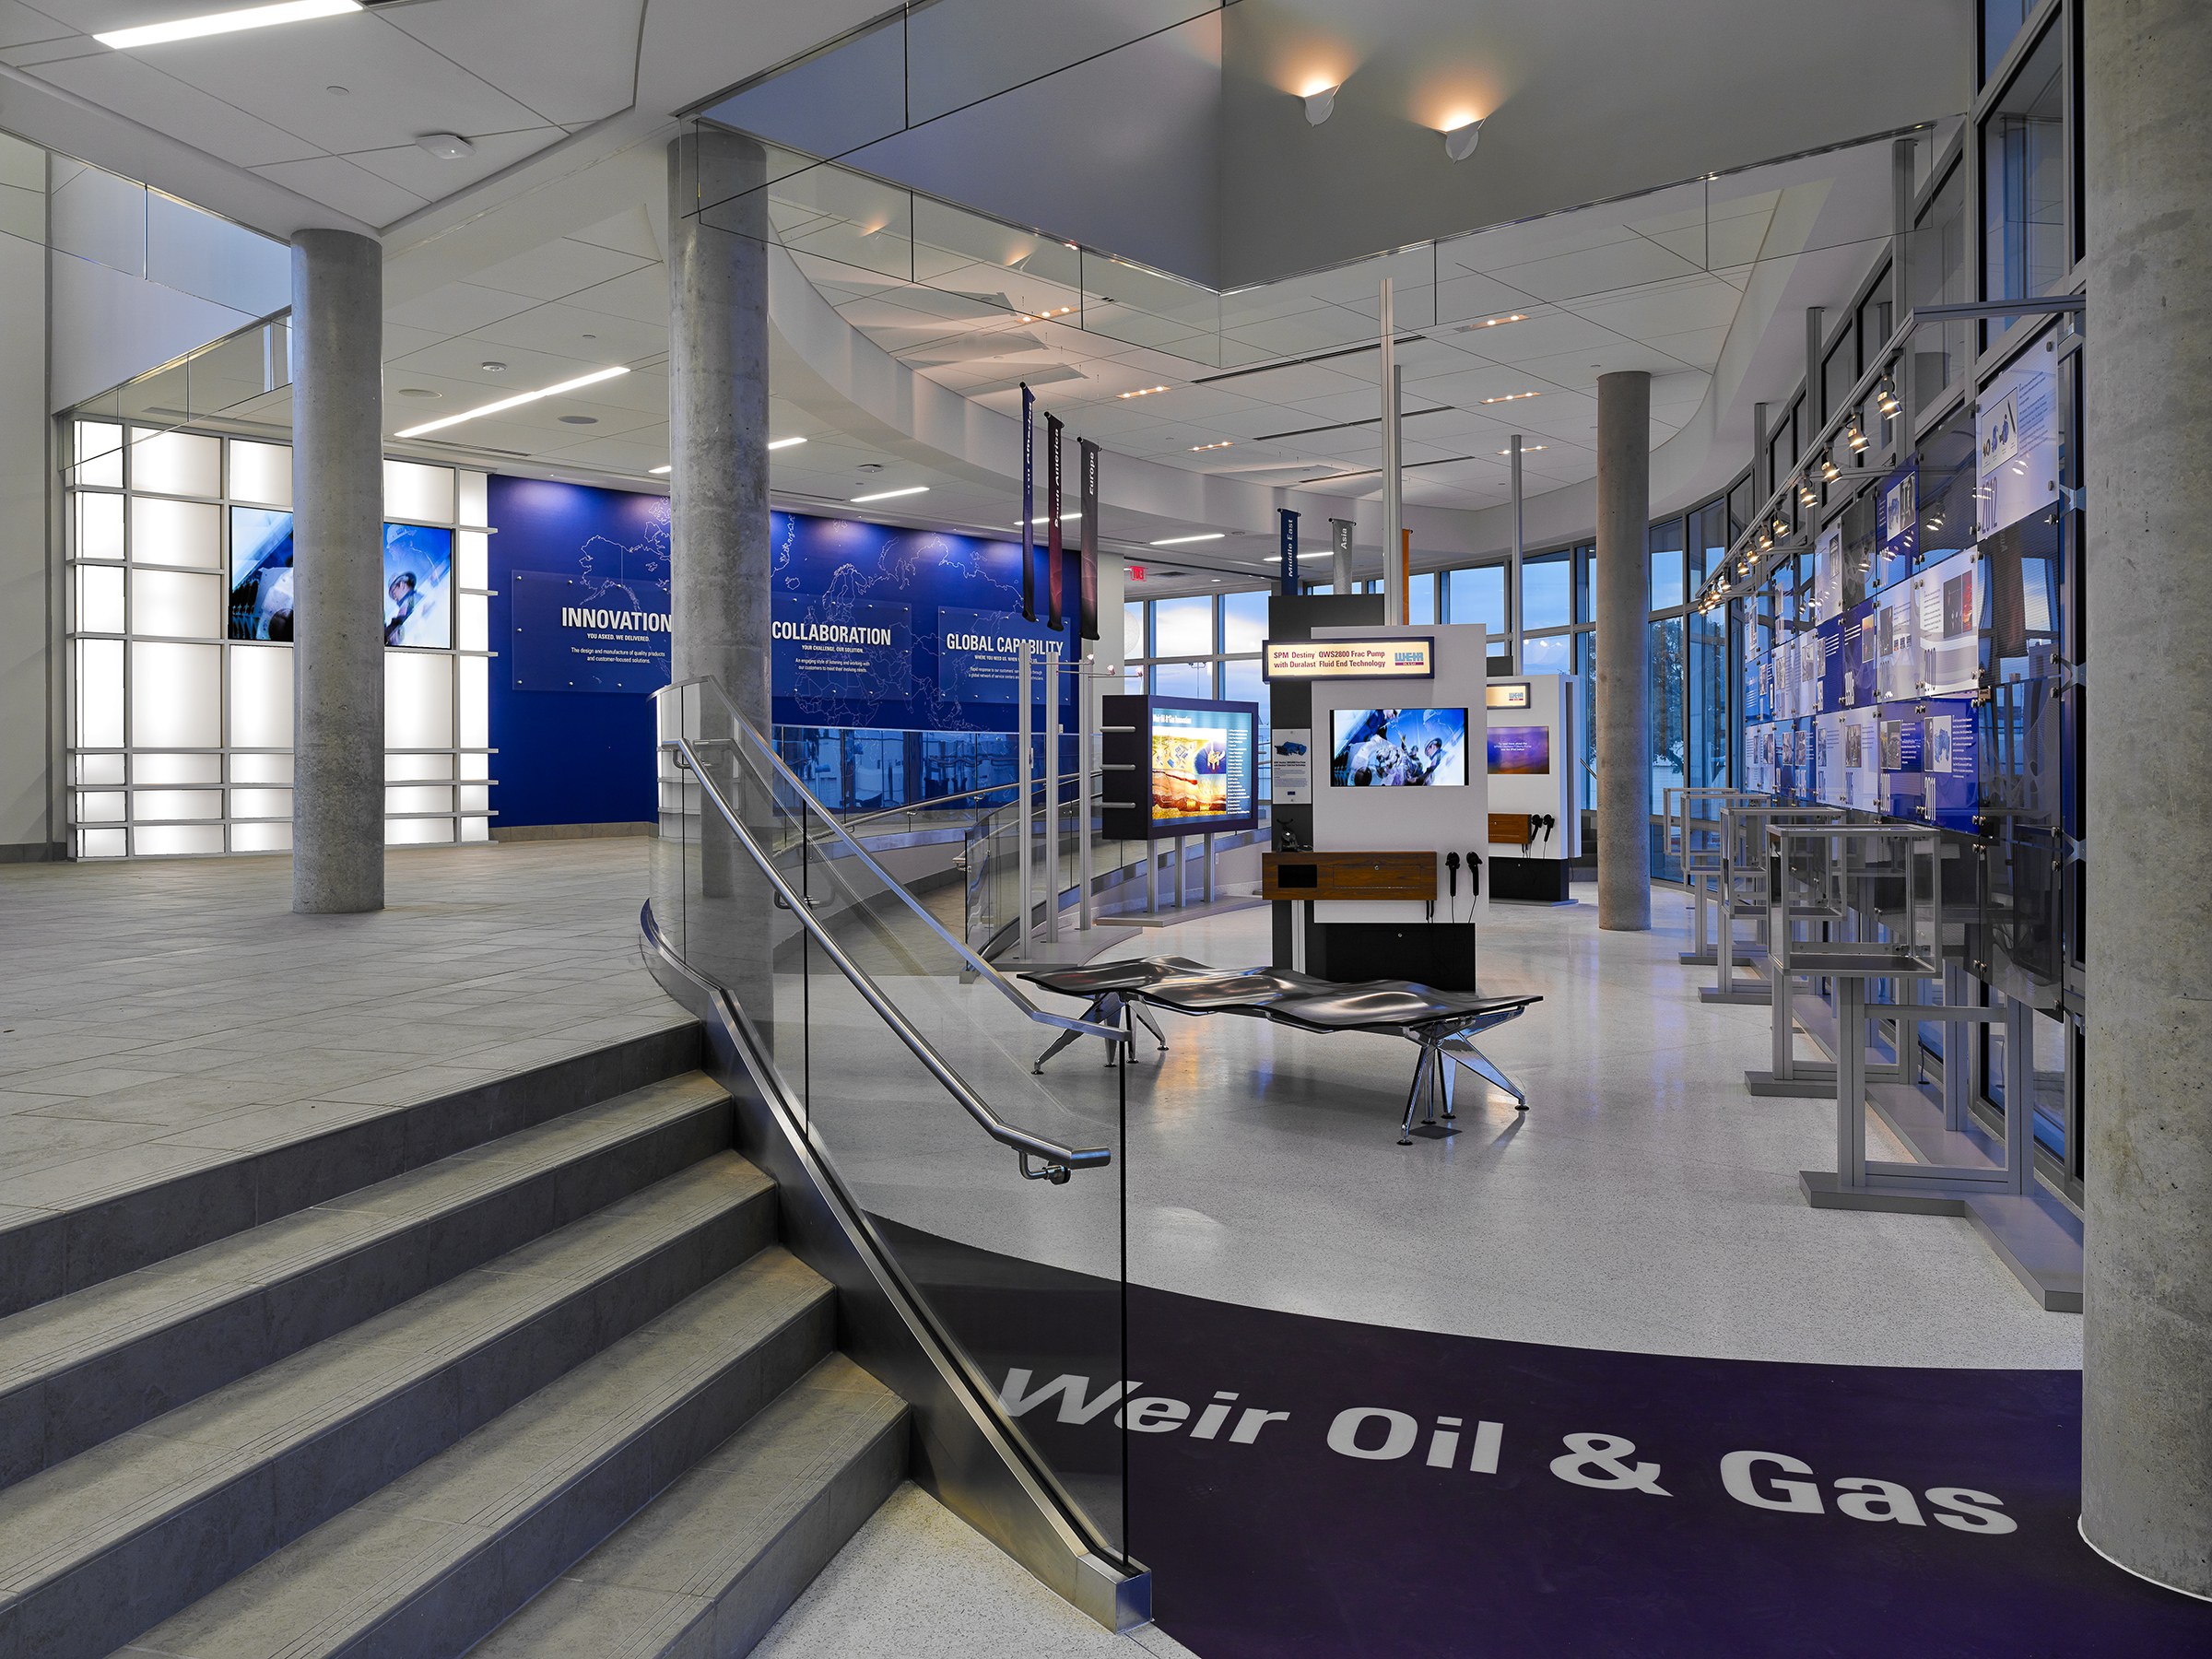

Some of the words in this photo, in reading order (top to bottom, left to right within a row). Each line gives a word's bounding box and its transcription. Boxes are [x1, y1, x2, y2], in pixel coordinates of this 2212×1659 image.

[1982, 476, 1998, 535] 2012
[561, 606, 672, 632] INNOVATION
[771, 620, 891, 645] COLLABORATION
[947, 633, 994, 652] GLOBAL
[1349, 660, 1386, 668] Technology
[1367, 650, 1385, 658] Pump
[1394, 652, 1424, 662] WEIR
[997, 1368, 1290, 1444] Weir
[1326, 1406, 1504, 1475] Oil
[1549, 1432, 1674, 1498] &
[1720, 1450, 2018, 1535] Gas
